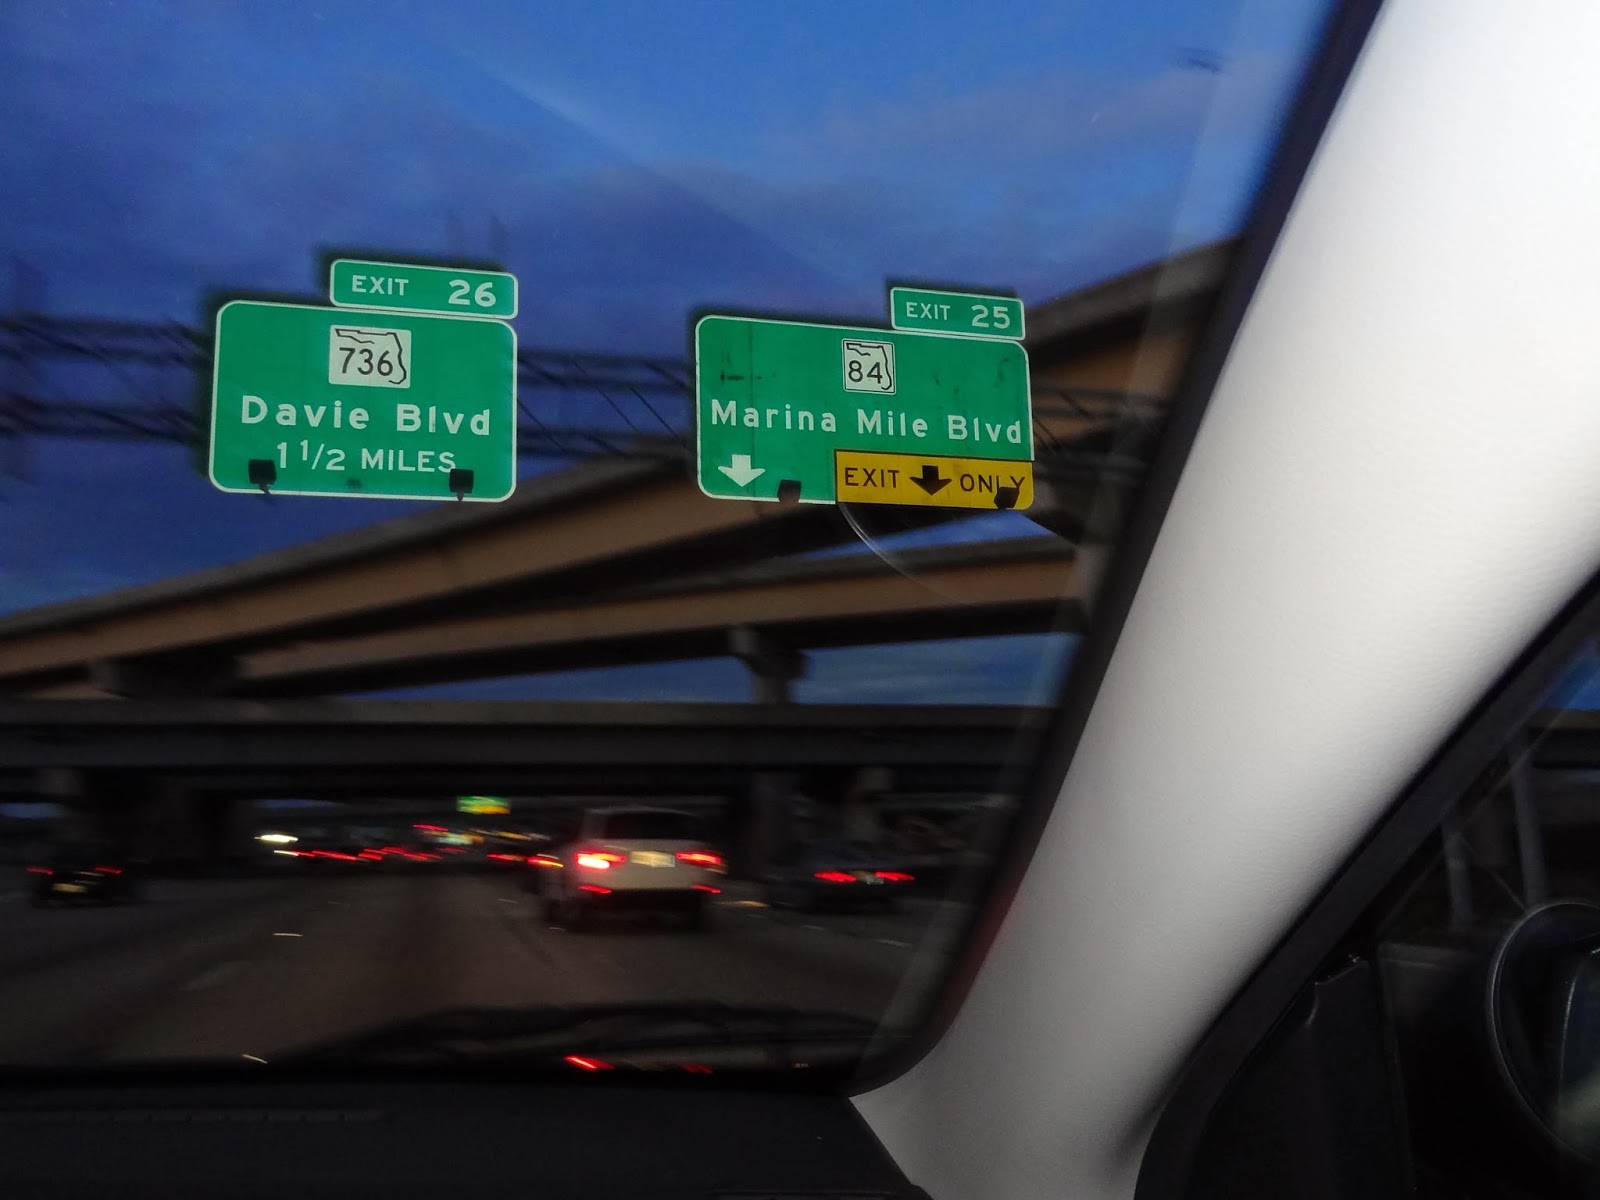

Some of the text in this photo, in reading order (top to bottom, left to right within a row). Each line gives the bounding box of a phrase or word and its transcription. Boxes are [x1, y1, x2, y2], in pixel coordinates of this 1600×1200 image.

[352, 275, 496, 307] EXIT 26
[906, 302, 1011, 329] EXIT 25
[339, 347, 394, 377] 736
[848, 360, 883, 384] 84
[241, 395, 490, 436] Davie Blvd
[711, 399, 1021, 444] Marina Mile Blvd
[361, 448, 456, 473] MILES
[844, 467, 900, 489] EXIT
